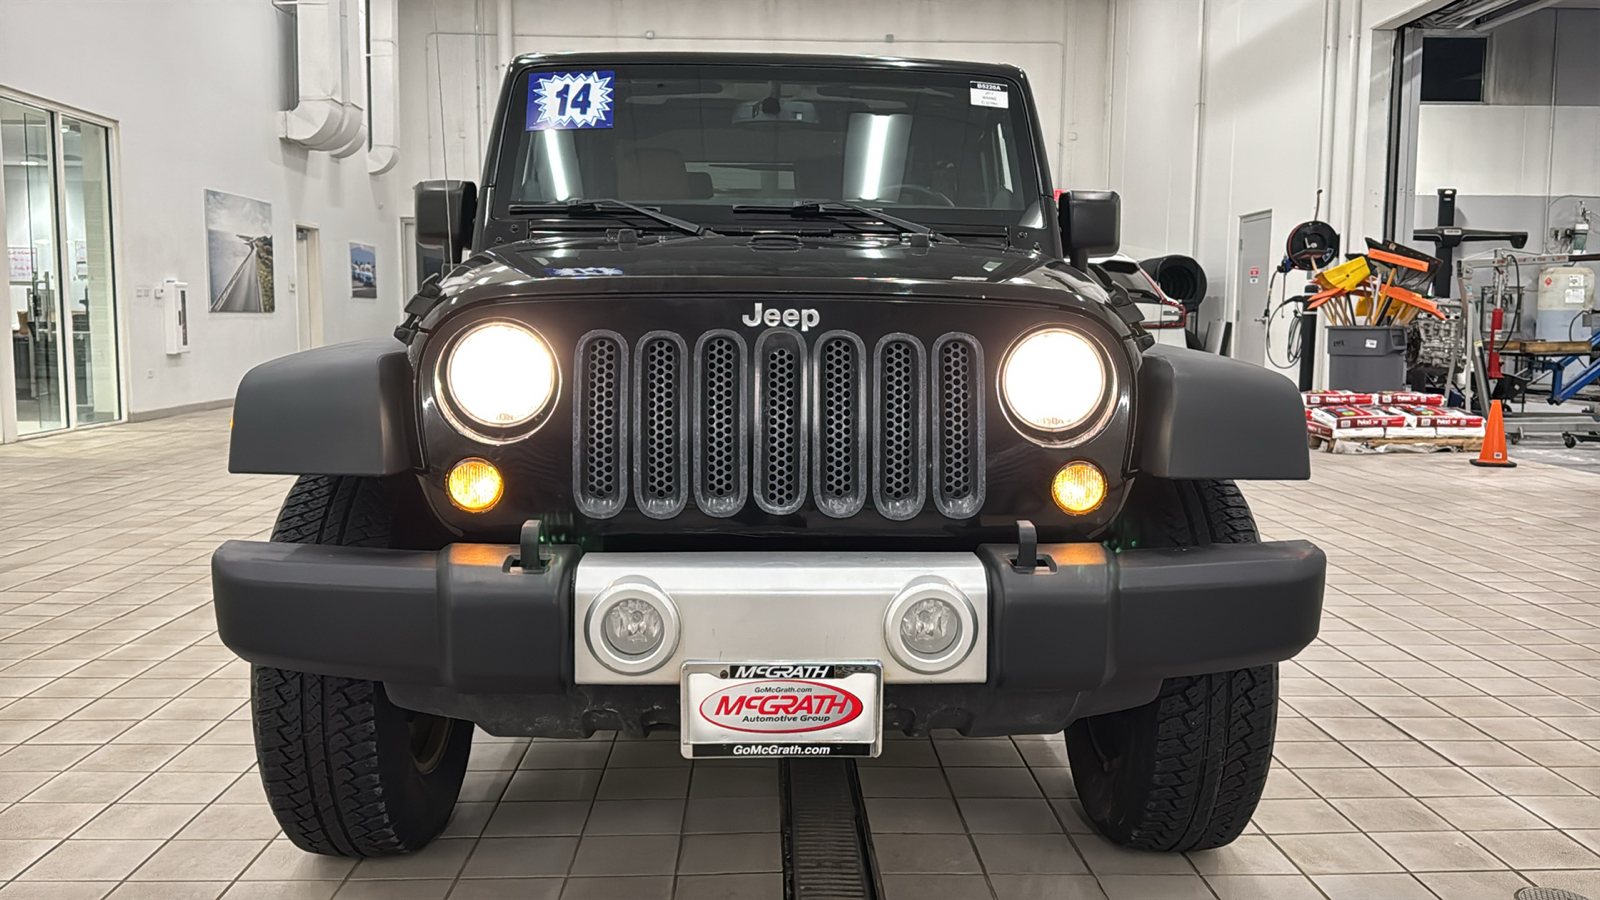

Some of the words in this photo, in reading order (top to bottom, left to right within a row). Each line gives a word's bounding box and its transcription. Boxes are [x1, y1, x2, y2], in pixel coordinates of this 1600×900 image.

[555, 83, 592, 116] 14
[742, 302, 820, 332] Jeep
[754, 686, 813, 694] GoMcGrath.com
[714, 694, 847, 716] McGRATH
[741, 715, 798, 723] Automotive
[800, 714, 831, 723] Group
[732, 745, 831, 755] GoMcGrath.com
